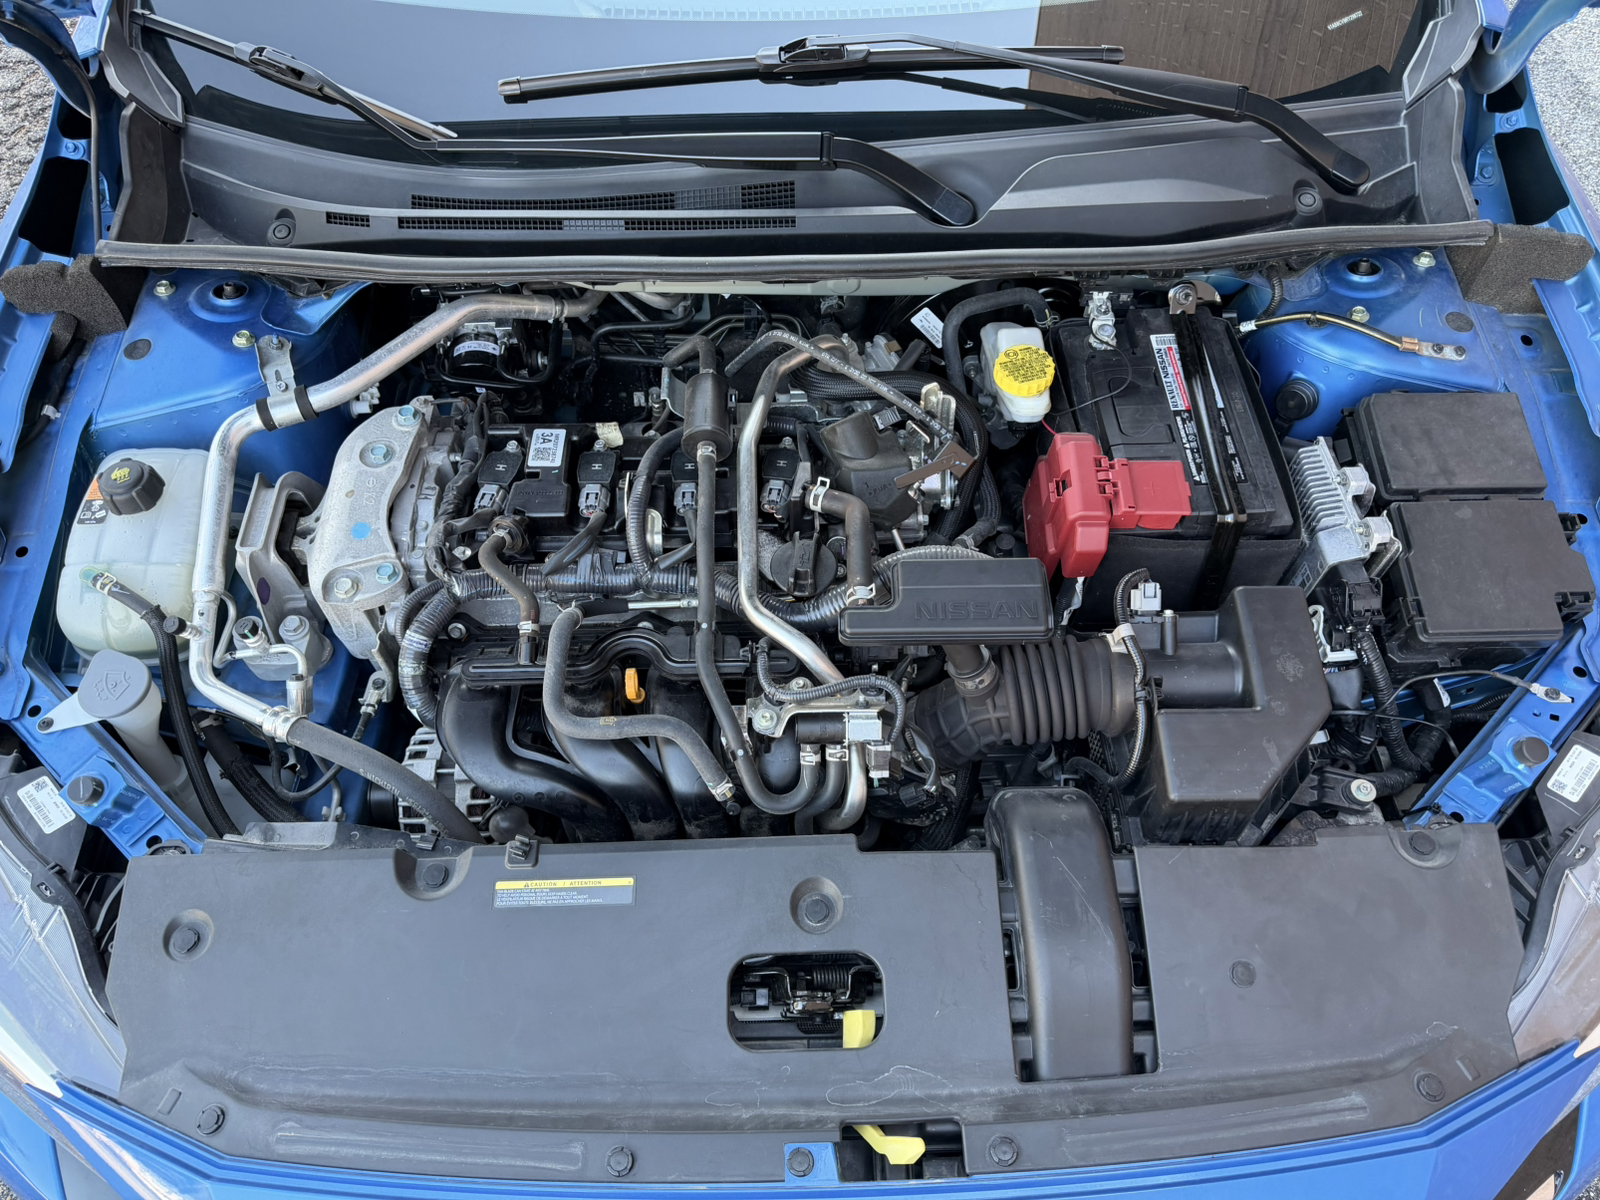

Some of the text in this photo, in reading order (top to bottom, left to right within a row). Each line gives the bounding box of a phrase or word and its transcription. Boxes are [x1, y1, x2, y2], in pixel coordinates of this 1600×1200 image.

[1155, 348, 1170, 379] NISSAN
[1165, 380, 1178, 408] RENAULT
[540, 432, 553, 444] 3A
[914, 601, 1038, 620] NISSAN
